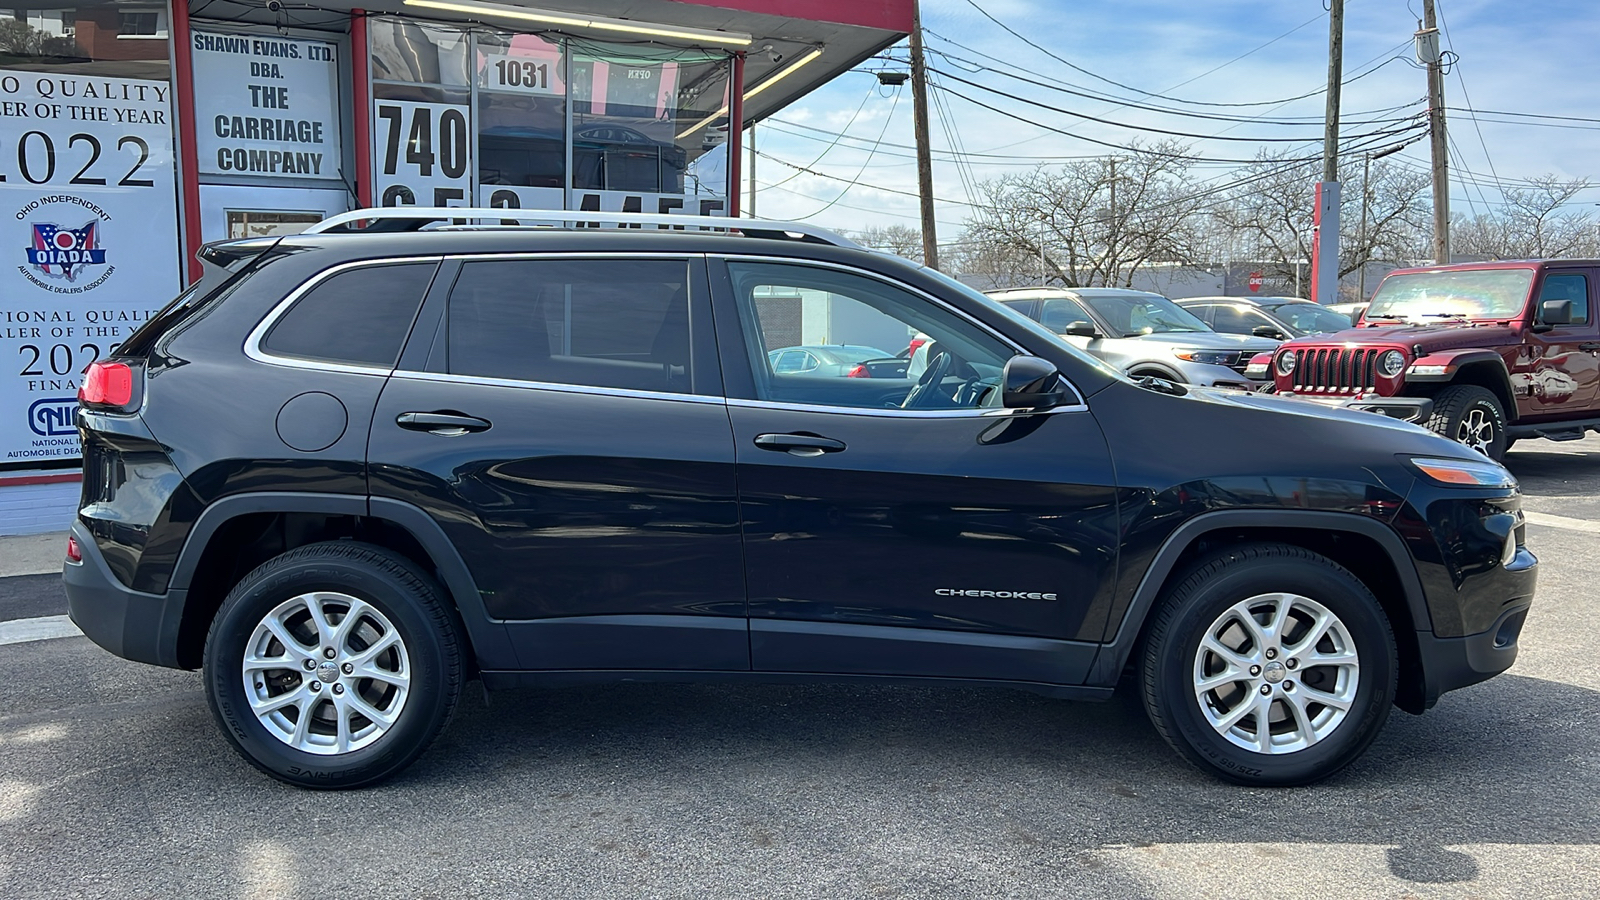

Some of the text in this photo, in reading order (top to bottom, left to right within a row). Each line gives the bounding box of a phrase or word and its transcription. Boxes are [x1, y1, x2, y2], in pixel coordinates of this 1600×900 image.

[194, 34, 335, 62] SHAWN EVANS. LTD.
[250, 62, 284, 79] DBA.
[495, 60, 548, 89] 1031
[36, 78, 167, 103] QUALITY
[248, 84, 289, 110] THE
[0, 101, 167, 125] ER OF THE YEAR
[214, 115, 324, 144] CARRIAGE
[378, 105, 467, 179] 740
[0, 130, 154, 188] 022
[217, 147, 323, 175] COMPANY
[16, 195, 112, 222] OHIO INDEPENDENT
[36, 250, 93, 264] OIADA
[18, 265, 116, 295] AUTOMOBILE DEALERS ASSOCIATION
[51, 327, 74, 338] OF
[83, 326, 120, 337] THE
[19, 343, 121, 376] 202
[28, 379, 84, 391] FINA
[7, 448, 61, 458] AUTOMOBILE
[32, 438, 74, 447] NATIONAL
[934, 588, 1058, 601] CHEROKEE
[1218, 758, 1263, 777] 225/65
